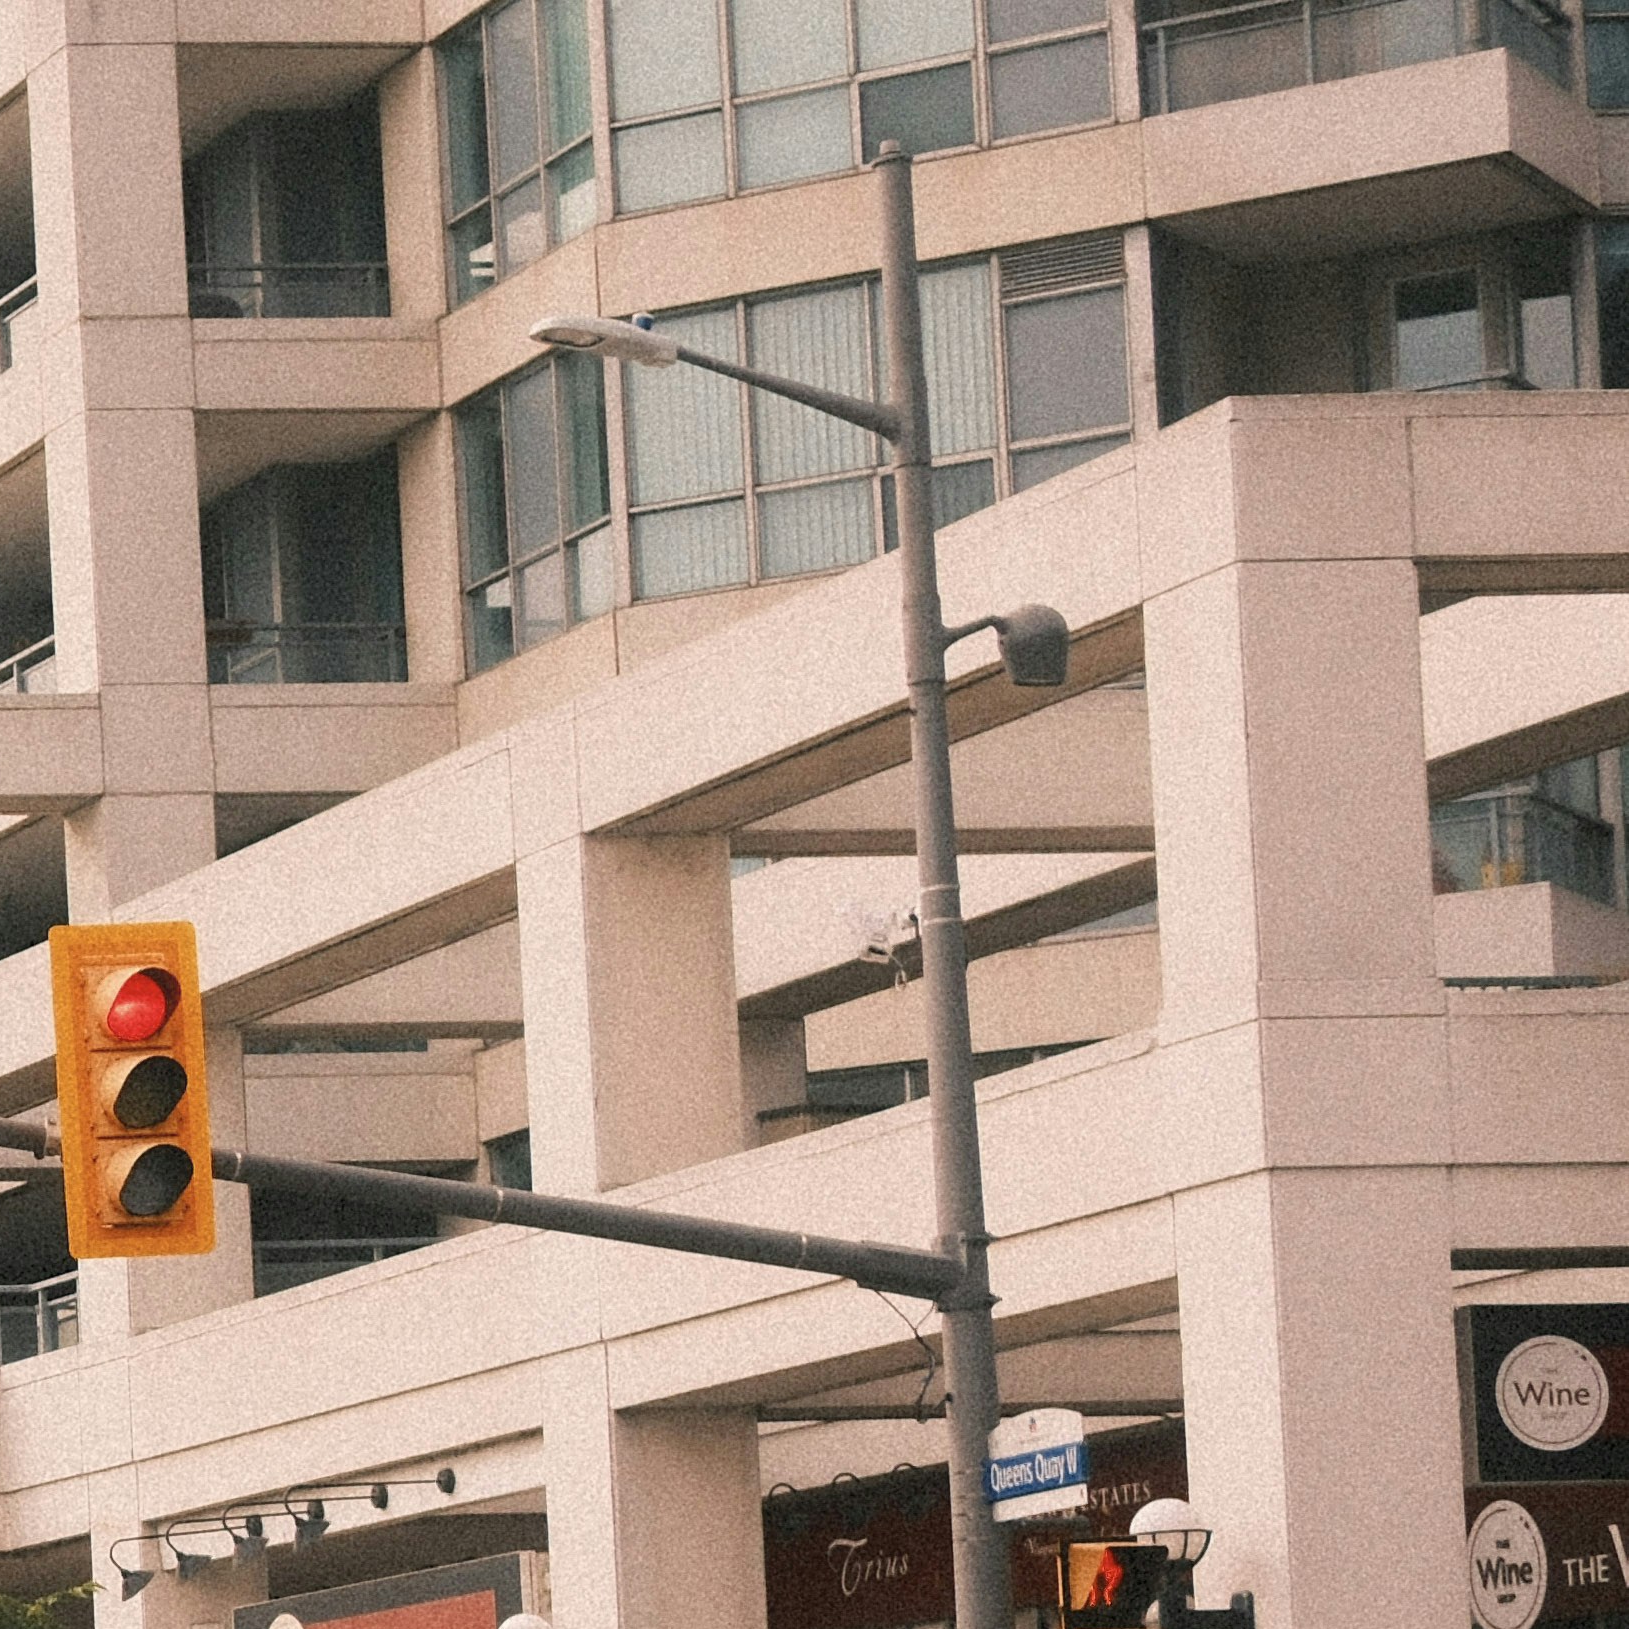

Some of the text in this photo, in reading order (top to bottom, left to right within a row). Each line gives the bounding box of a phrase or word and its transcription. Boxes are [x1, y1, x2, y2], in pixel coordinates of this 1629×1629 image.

[1513, 1381, 1590, 1407] Wine
[990, 1446, 1077, 1494] Queens Quay W
[1087, 1480, 1151, 1508] STATES
[826, 1538, 908, 1596] Trius
[1476, 1556, 1533, 1590] Wine
[1563, 1554, 1610, 1587] THE
